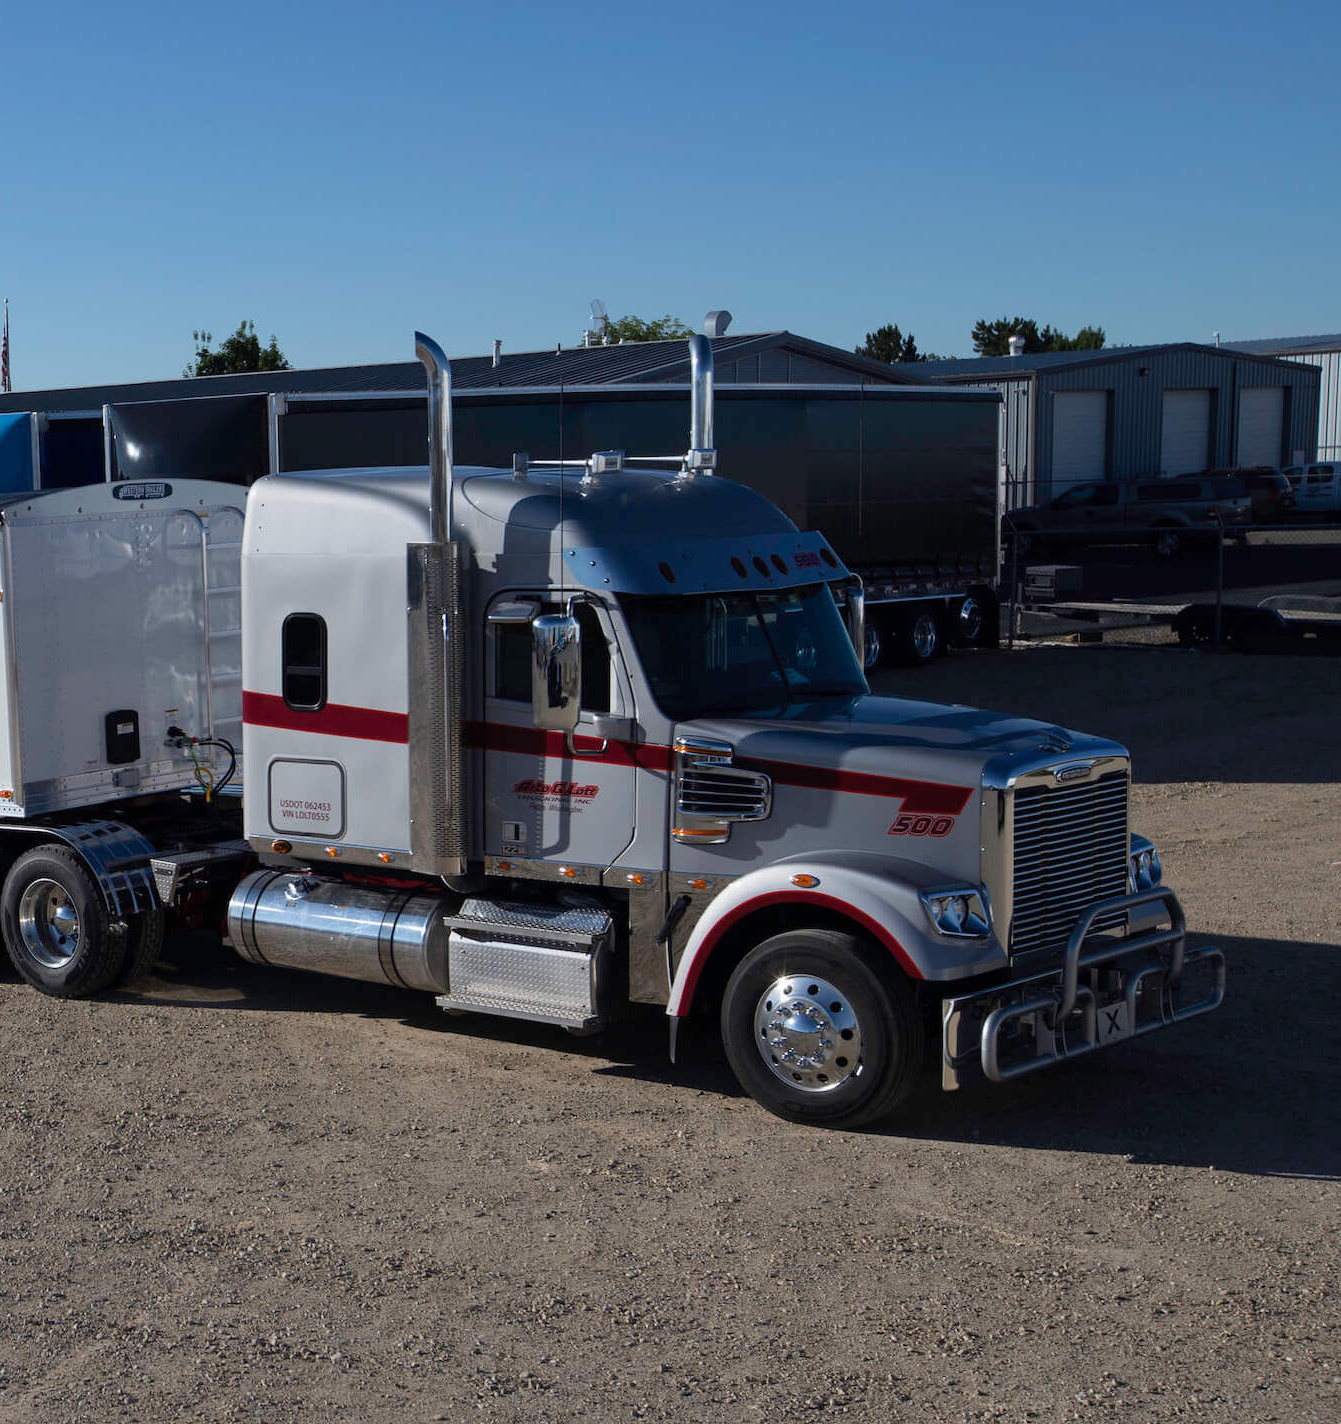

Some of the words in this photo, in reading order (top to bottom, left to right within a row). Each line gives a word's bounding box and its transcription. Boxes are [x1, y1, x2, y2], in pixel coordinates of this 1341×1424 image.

[280, 800, 303, 809] USDOT
[282, 810, 295, 818] VIN
[889, 815, 955, 837] 500
[1105, 1009, 1120, 1034] X
